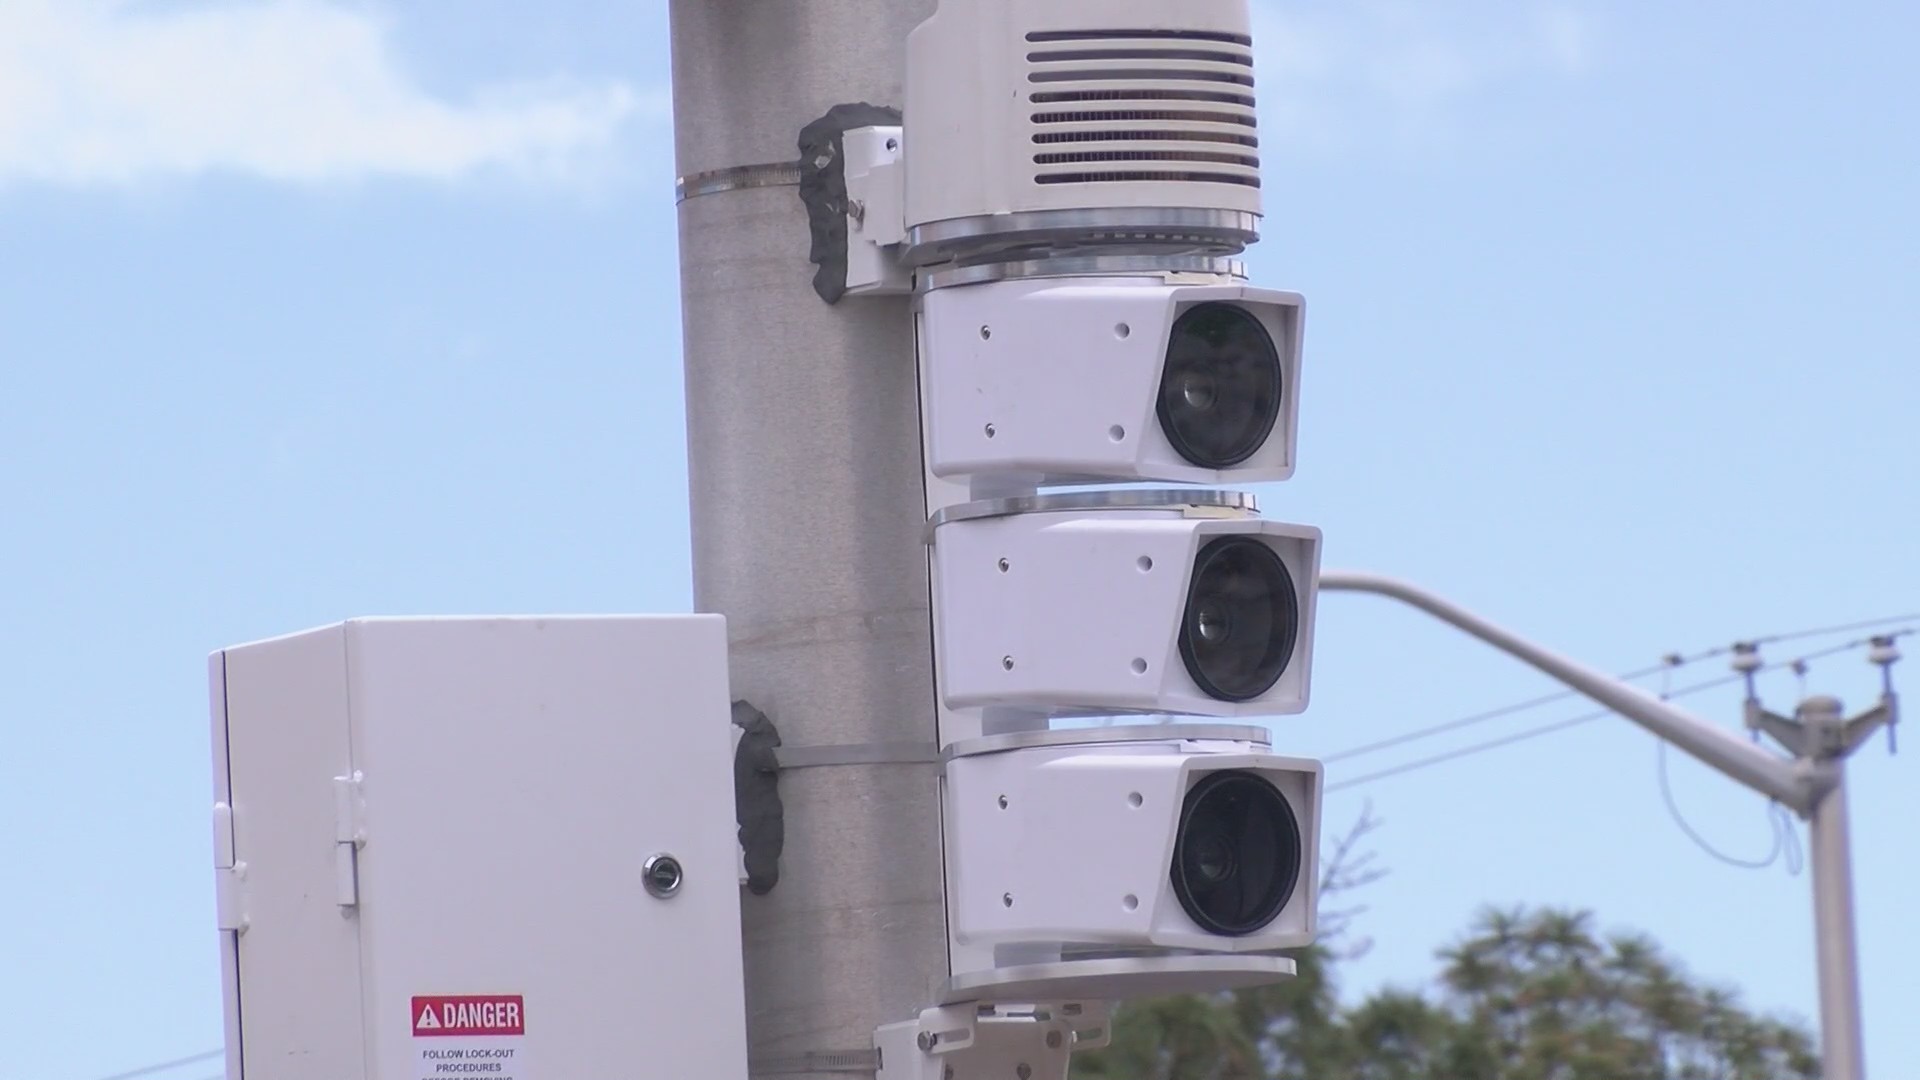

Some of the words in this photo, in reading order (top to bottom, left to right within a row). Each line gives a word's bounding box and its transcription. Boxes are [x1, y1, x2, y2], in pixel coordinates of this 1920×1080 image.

[443, 1002, 520, 1028] DANGER
[423, 1049, 464, 1059] FOLLOW
[465, 1049, 515, 1058] LOCK-OUT
[436, 1063, 502, 1072] PROCEDURES
